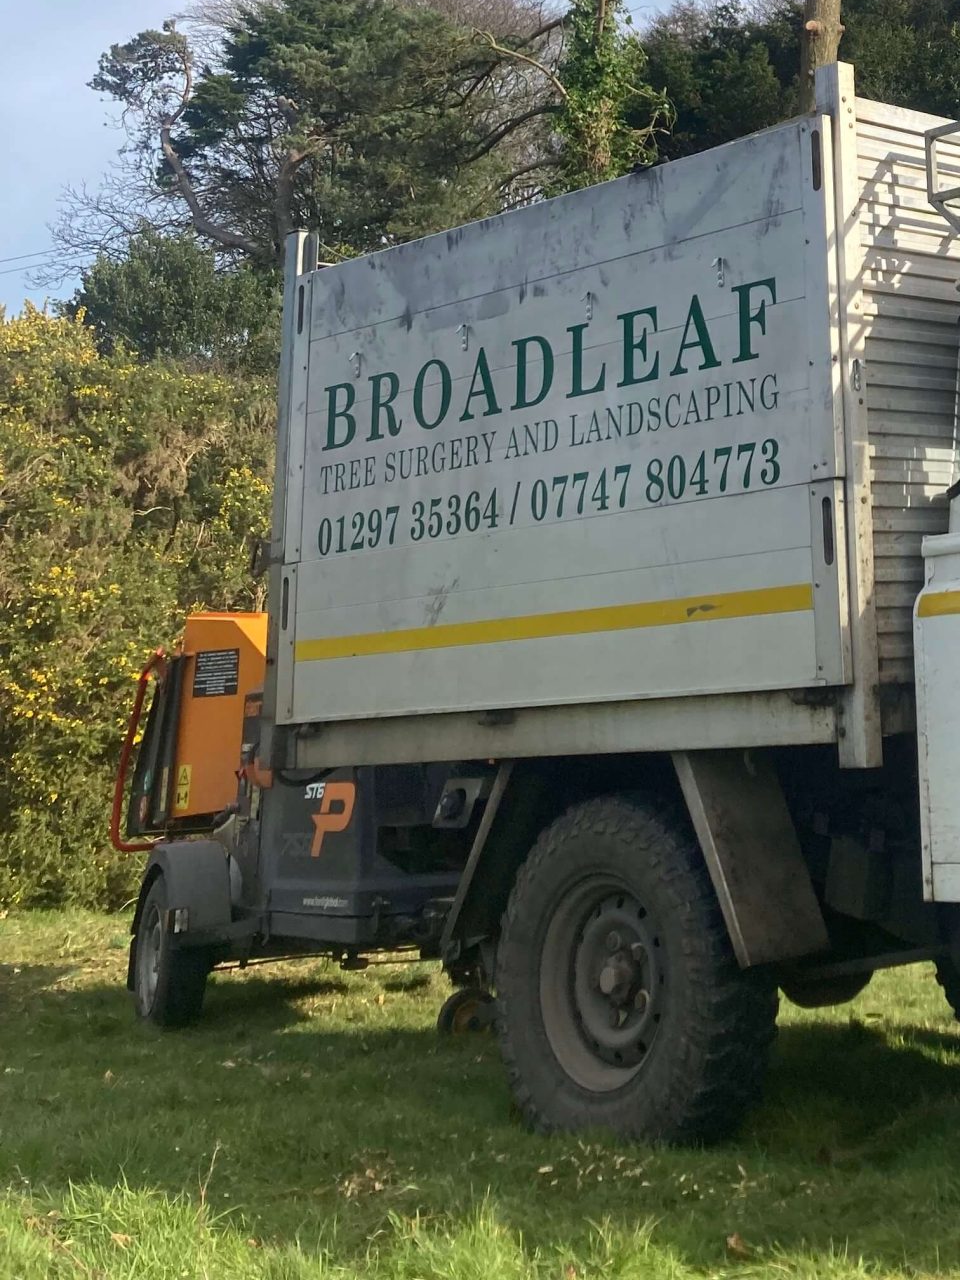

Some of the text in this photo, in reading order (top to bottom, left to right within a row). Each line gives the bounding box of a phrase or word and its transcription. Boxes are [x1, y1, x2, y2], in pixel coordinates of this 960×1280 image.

[322, 277, 777, 451] BROADLEAF
[320, 374, 780, 494] TREE SURGERY AND LANDSCAPING
[318, 505, 400, 556] 01297
[410, 487, 499, 541] 35364
[531, 464, 632, 521] 07747
[646, 438, 781, 503] 804773
